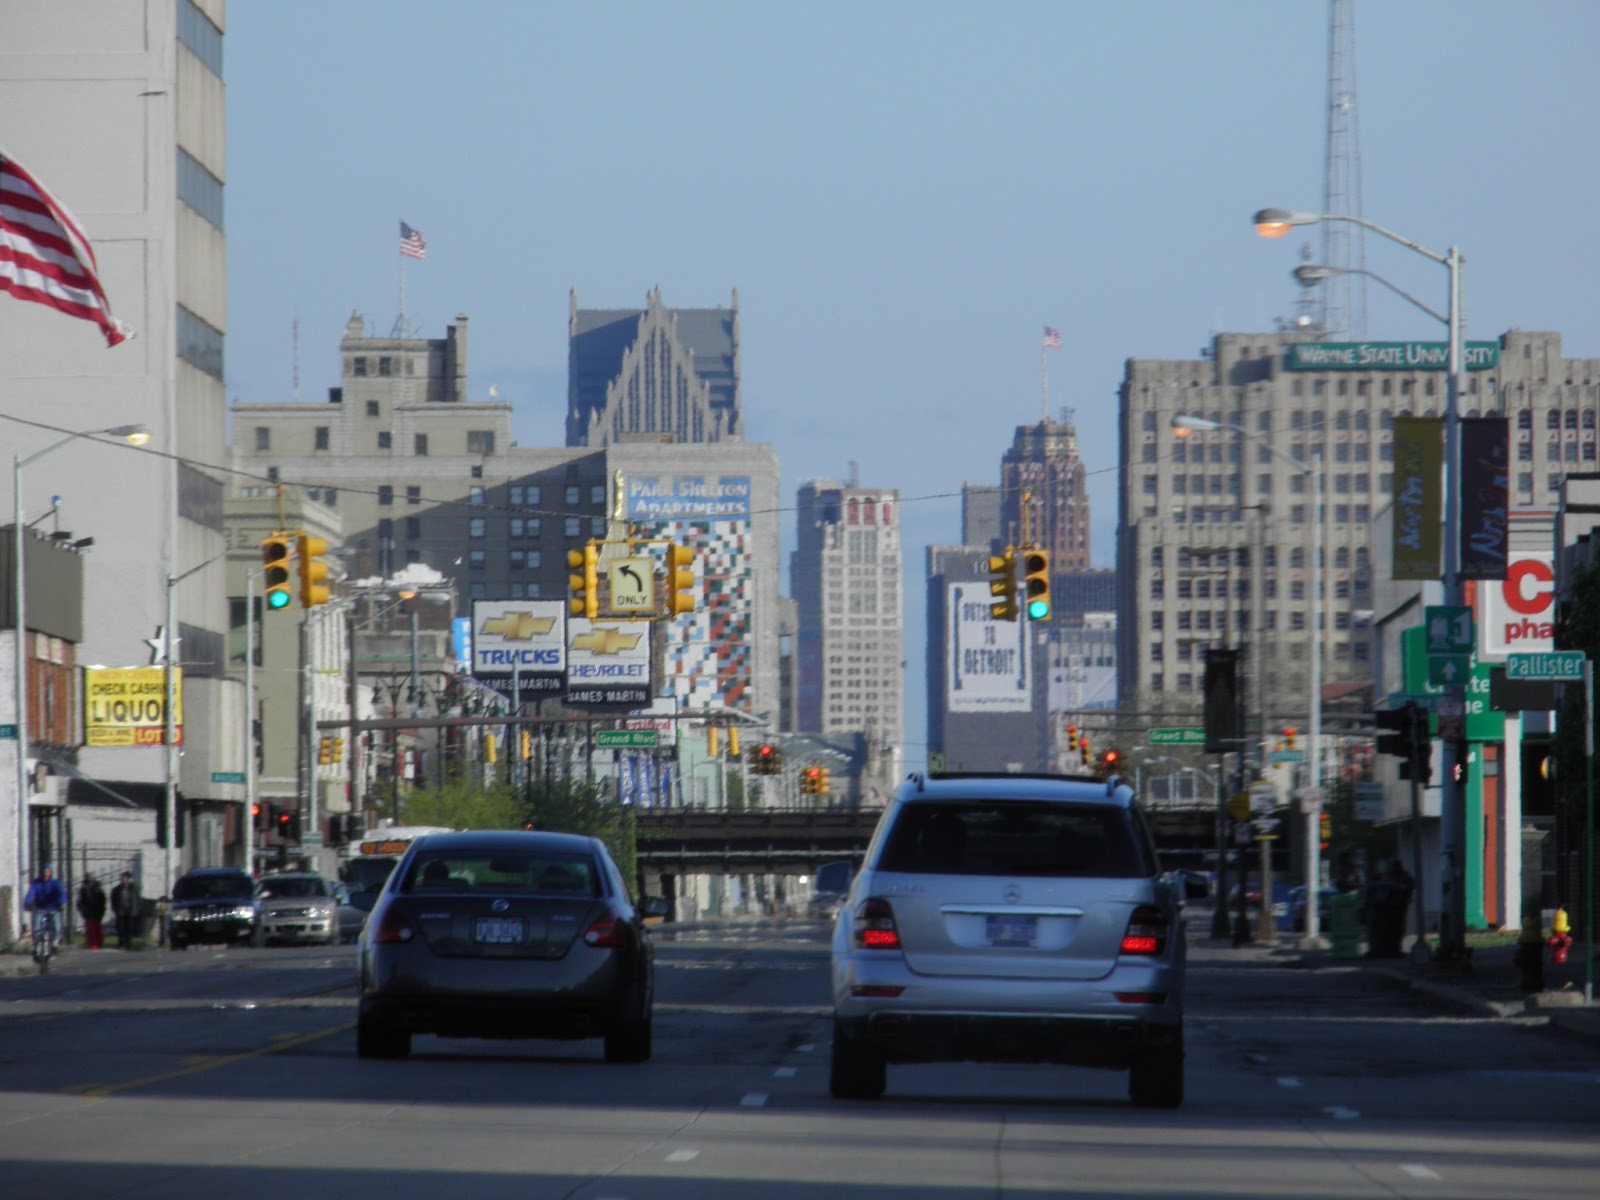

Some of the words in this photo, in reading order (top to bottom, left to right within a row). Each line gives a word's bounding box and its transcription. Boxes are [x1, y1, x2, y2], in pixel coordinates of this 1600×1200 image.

[1298, 345, 1356, 364] WAYNE
[1357, 344, 1404, 365] STATE
[1405, 344, 1494, 364] UNIVSITY
[634, 500, 746, 517] APARTMENTS
[617, 595, 648, 606] ONLY
[479, 649, 559, 664] TRUCKS
[964, 648, 1015, 675] DETROIT
[1508, 655, 1584, 676] Pallister
[91, 683, 127, 696] CHECK
[481, 679, 514, 690] AMES
[519, 678, 561, 690] MARTIN
[607, 690, 647, 702] MARTIN
[92, 699, 177, 723] LIQUO
[138, 728, 180, 743] LOTO
[600, 734, 630, 744] Grand
[633, 733, 656, 744] Blvd
